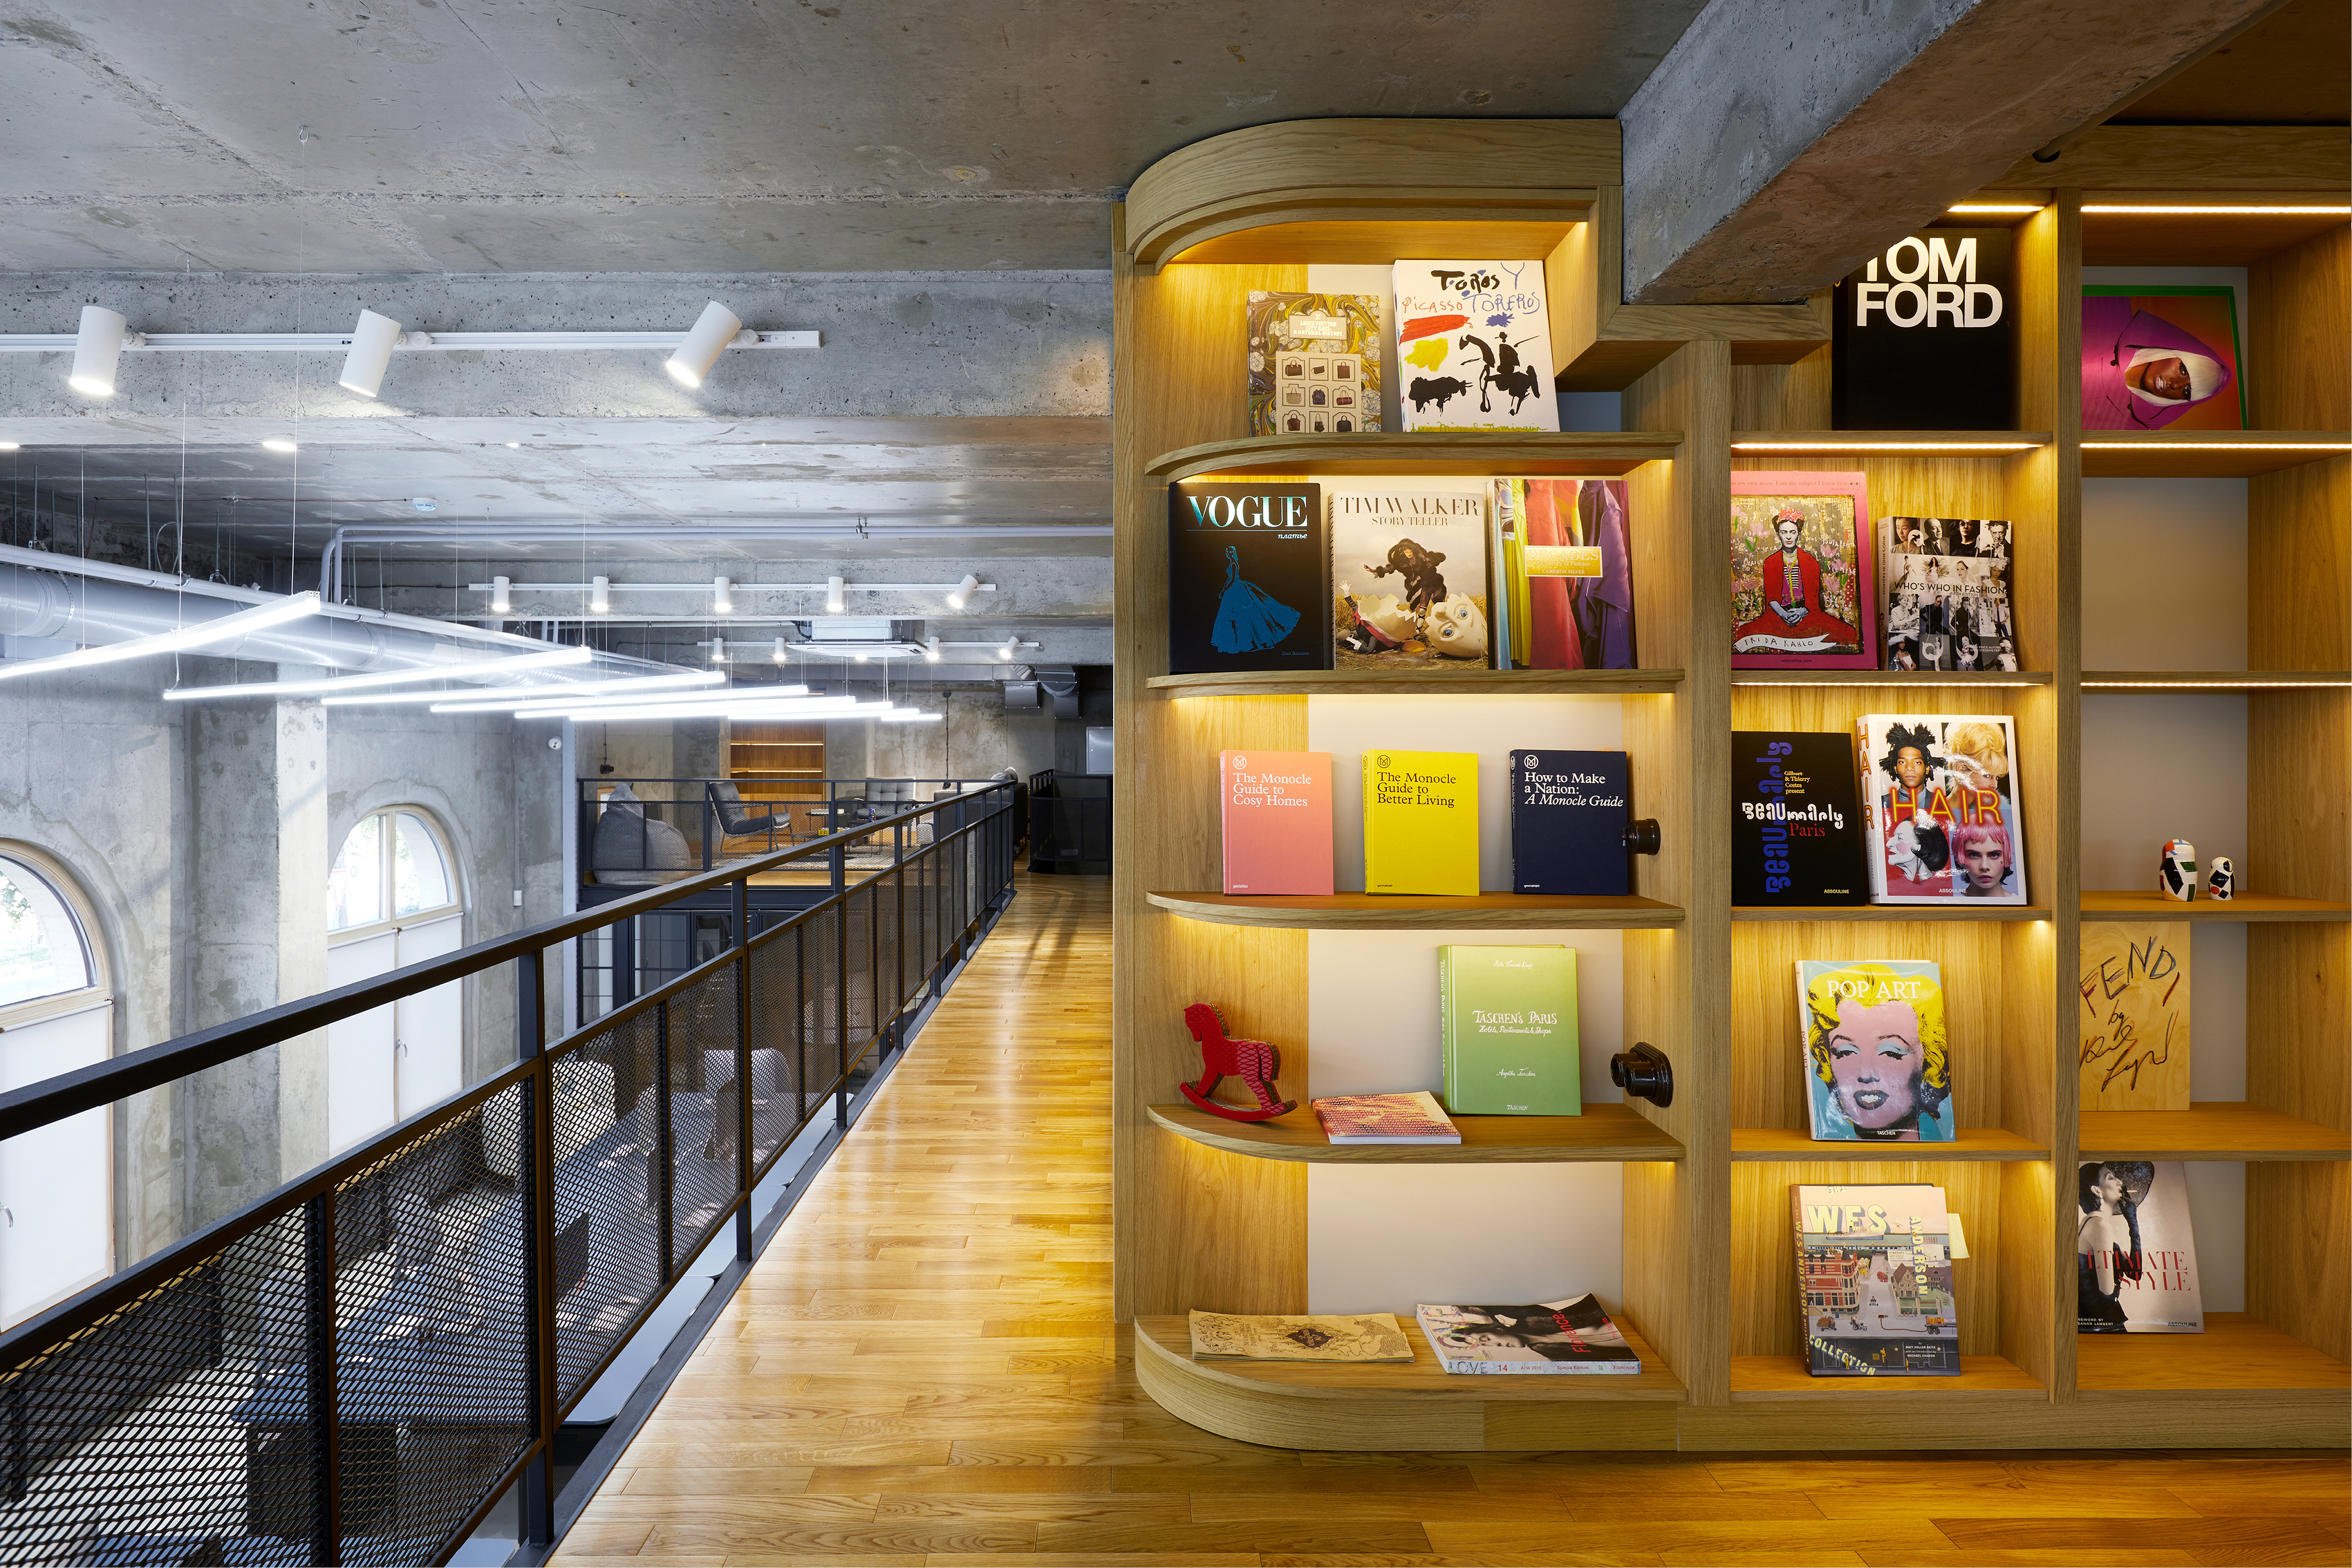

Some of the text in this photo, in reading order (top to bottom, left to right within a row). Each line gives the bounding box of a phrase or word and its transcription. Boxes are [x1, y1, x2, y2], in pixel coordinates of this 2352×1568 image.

[1500, 262, 1524, 290] Y
[1462, 292, 1540, 315] TOREROS
[1857, 283, 2003, 328] FORD
[1186, 495, 1307, 528] VOGUE
[1340, 497, 1479, 516] TIM WALKER
[1372, 516, 1448, 526] STORY TELLER
[1528, 550, 1598, 561] DECADES
[1894, 581, 1925, 590] WHO'S
[1928, 584, 1950, 592] WHO
[1964, 585, 2004, 595] FASHION
[1784, 639, 1813, 647] KAHLO
[1233, 773, 1312, 784] The Monocle
[1376, 772, 1456, 783] The Monocle
[1524, 772, 1606, 784] How to Make
[1857, 723, 1874, 831] HAIR
[1233, 783, 1285, 794] Guide to
[1377, 782, 1413, 793] Guide
[1534, 783, 1579, 794] Nation:
[1233, 794, 1308, 808] Cosy Homes
[1377, 793, 1455, 808] Better Living
[1524, 794, 1623, 807] A Monocle Guide
[1891, 787, 2003, 824] HAIR
[1789, 823, 1825, 837] Paris
[1826, 980, 1921, 999] POP ART
[1527, 1011, 1558, 1025] PARIS
[1479, 1025, 1499, 1034] Hotels,
[1499, 1025, 1530, 1034] Restaurants
[1535, 1026, 1551, 1037] Shops
[1517, 1067, 1536, 1076] Taschen
[1806, 1204, 1891, 1233] WES
[1795, 1221, 1804, 1248] WES
[1909, 1216, 1928, 1296] ANDERSON
[1798, 1251, 1809, 1316] ANDERSON
[2118, 1271, 2191, 1291] STYLE
[1552, 1311, 1592, 1353] Florence.
[1809, 1334, 1876, 1376] COLLECTION
[1448, 1361, 1488, 1374] LOVE
